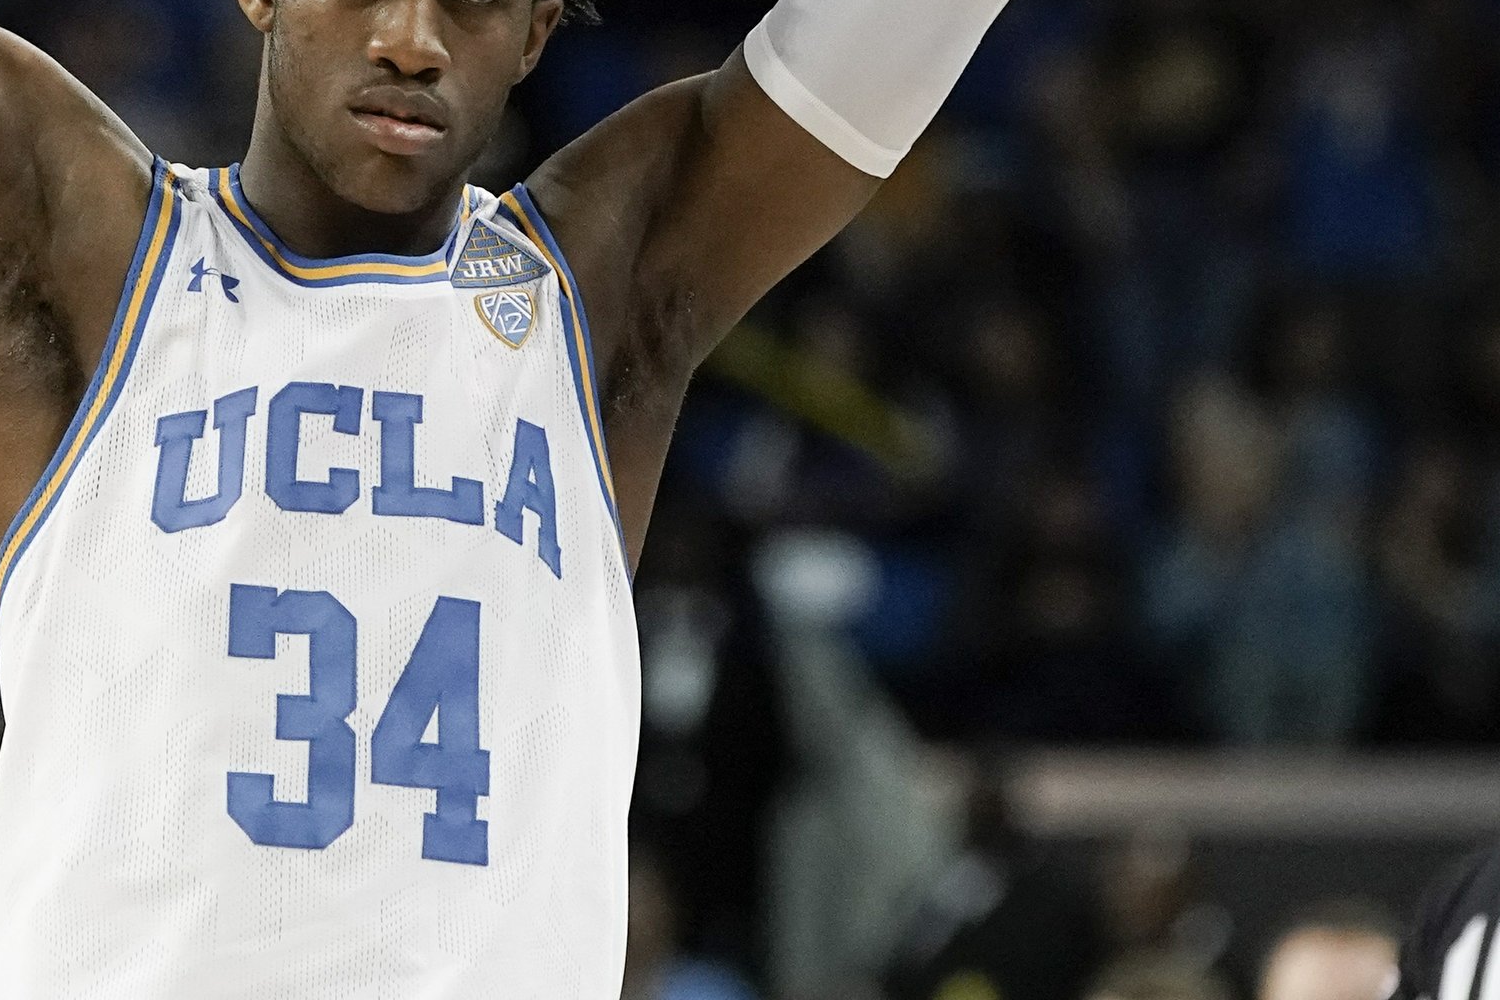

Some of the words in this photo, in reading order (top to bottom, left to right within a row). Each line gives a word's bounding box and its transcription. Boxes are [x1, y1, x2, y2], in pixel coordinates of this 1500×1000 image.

[463, 254, 523, 278] JRW
[480, 291, 532, 325] PAC
[498, 312, 528, 335] 12
[151, 382, 562, 580] UCLA
[227, 583, 490, 866] 34
